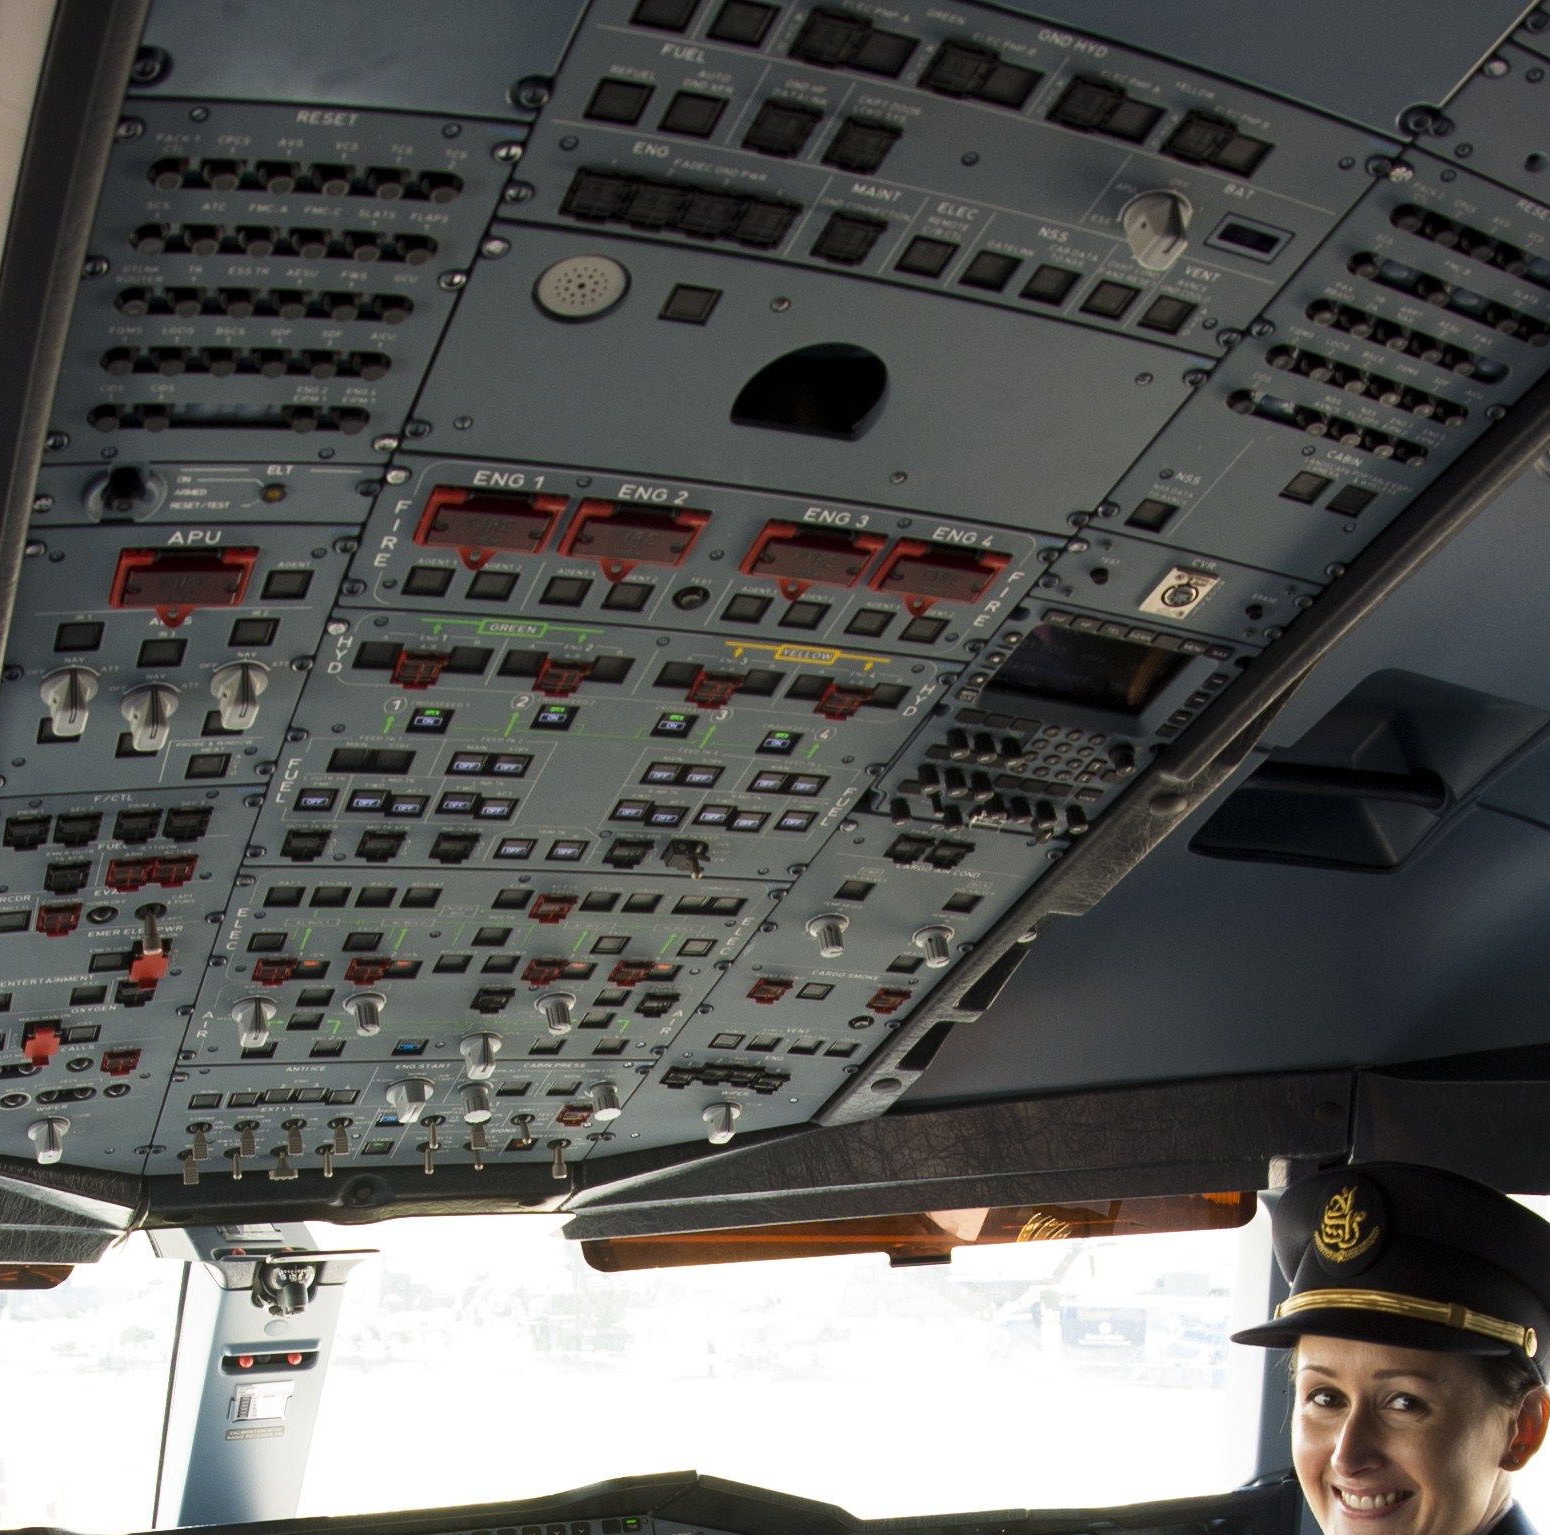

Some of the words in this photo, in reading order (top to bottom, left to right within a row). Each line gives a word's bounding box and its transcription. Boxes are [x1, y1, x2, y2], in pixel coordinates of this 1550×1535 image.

[660, 43, 709, 63] FUEL
[296, 110, 359, 126] RESET
[632, 142, 670, 158] ENG
[851, 182, 902, 203] MAINT
[1223, 184, 1256, 200] BAT
[937, 202, 979, 221] ELEC
[267, 465, 294, 475] ELT
[473, 470, 525, 489] ENG
[618, 484, 669, 502] ENG
[674, 490, 689, 505] 2
[803, 506, 852, 526] ENG
[856, 513, 870, 528] 3
[167, 531, 222, 545] APU
[932, 526, 977, 546] ENG
[981, 534, 994, 548] 4
[489, 623, 537, 635] GREEN
[781, 648, 835, 662] YELLOW
[87, 929, 121, 937] EMER
[0, 974, 95, 988] ENTERTAINMENT
[846, 972, 880, 980] SMOKE
[71, 1005, 118, 1015] OXYGEN
[417, 1062, 451, 1070] START
